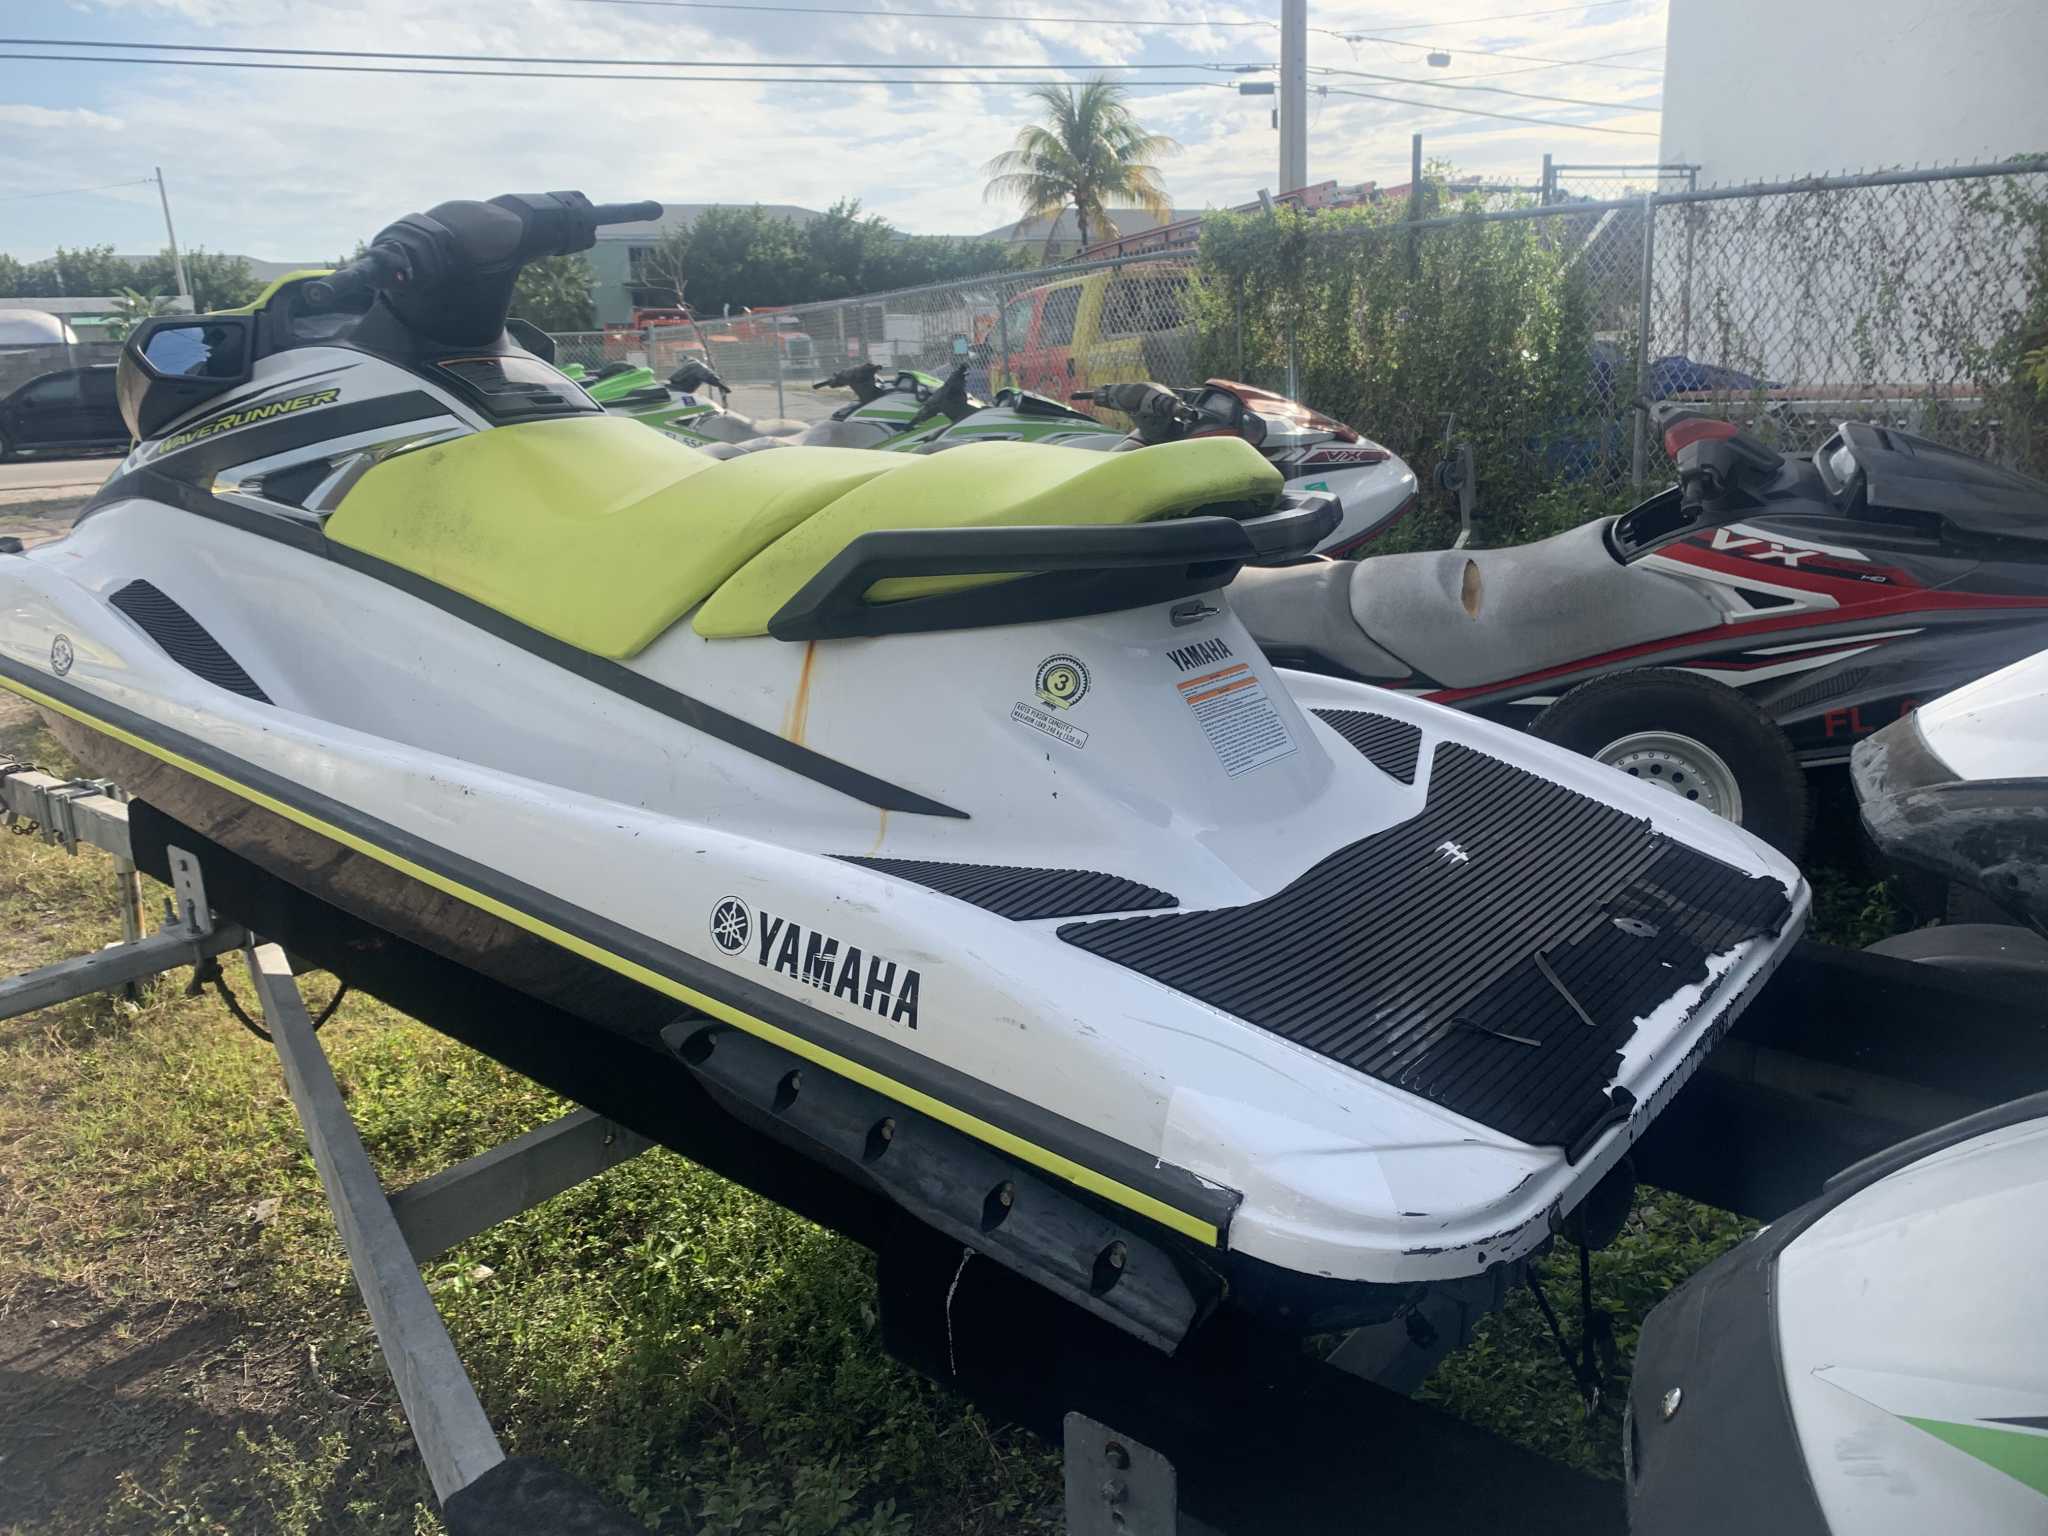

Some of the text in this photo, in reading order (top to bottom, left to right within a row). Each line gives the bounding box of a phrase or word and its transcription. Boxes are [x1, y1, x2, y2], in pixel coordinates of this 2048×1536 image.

[1327, 449, 1361, 463] VX
[1711, 527, 1821, 567] VX
[1166, 637, 1234, 672] YAMAHA
[1054, 673, 1070, 692] 3
[1824, 705, 1874, 737] FL
[758, 911, 921, 1031] YAMAHA
